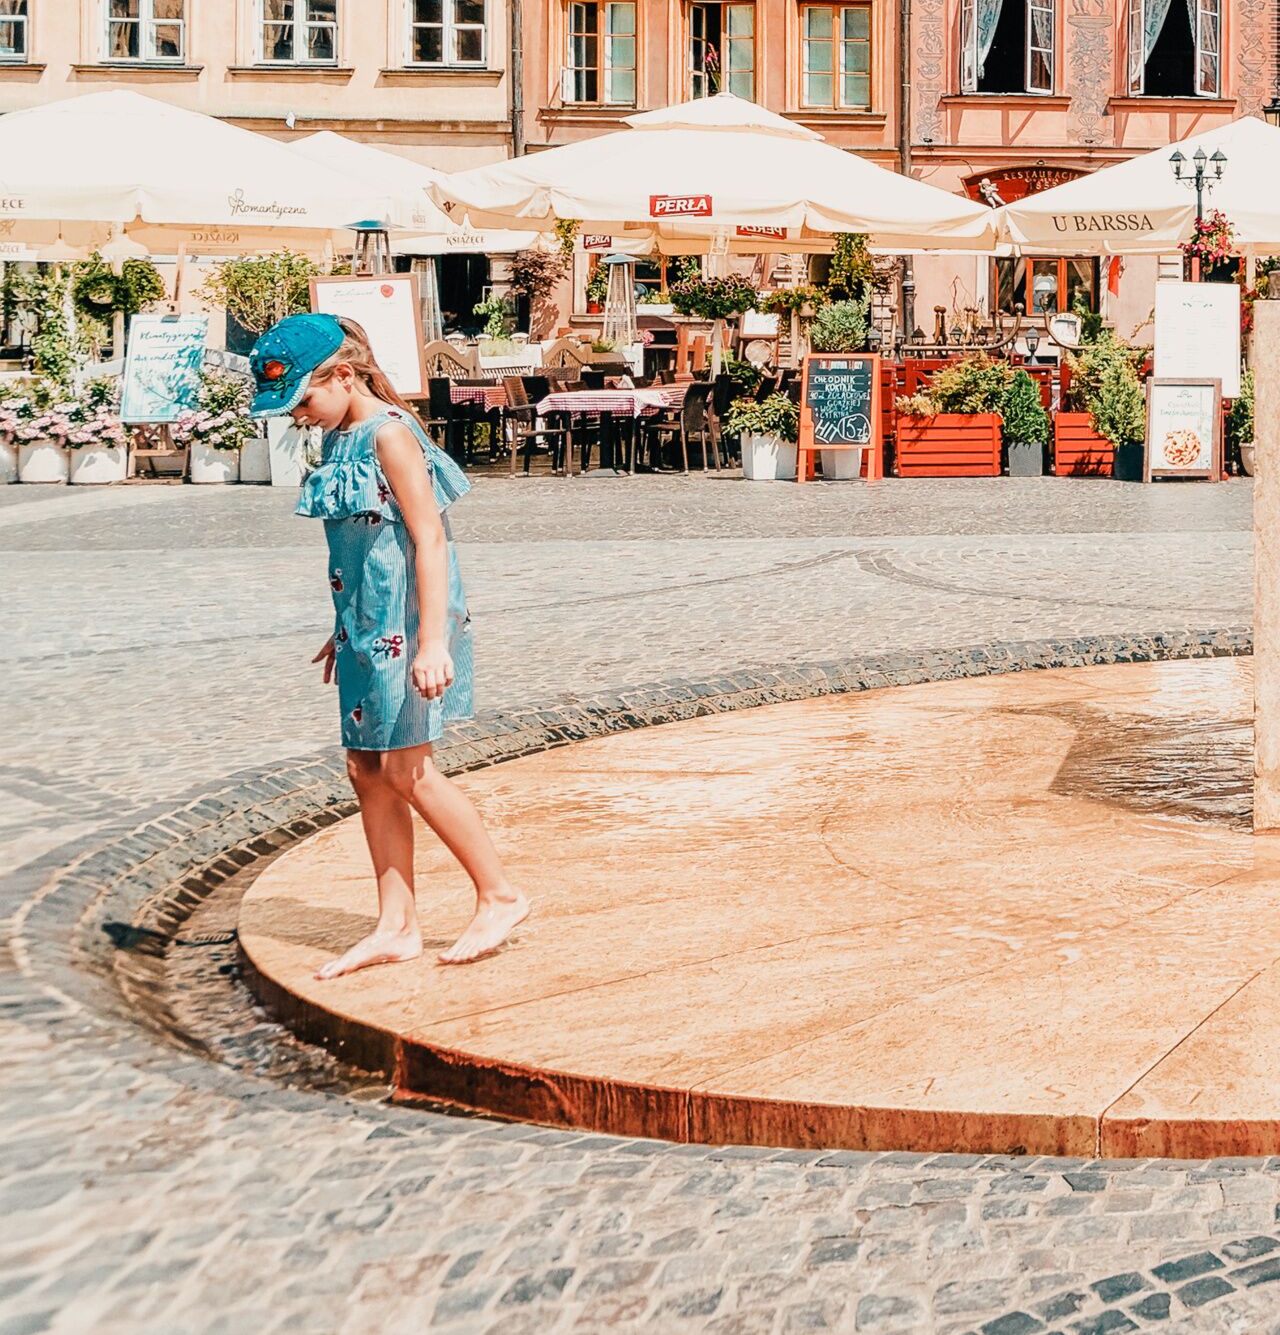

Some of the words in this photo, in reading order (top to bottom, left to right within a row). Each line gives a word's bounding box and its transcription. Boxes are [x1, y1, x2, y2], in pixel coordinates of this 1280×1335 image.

[654, 198, 708, 213] PERŁA
[1052, 215, 1068, 232] U
[1073, 214, 1154, 232] BARSSA
[585, 236, 610, 247] PERŁA
